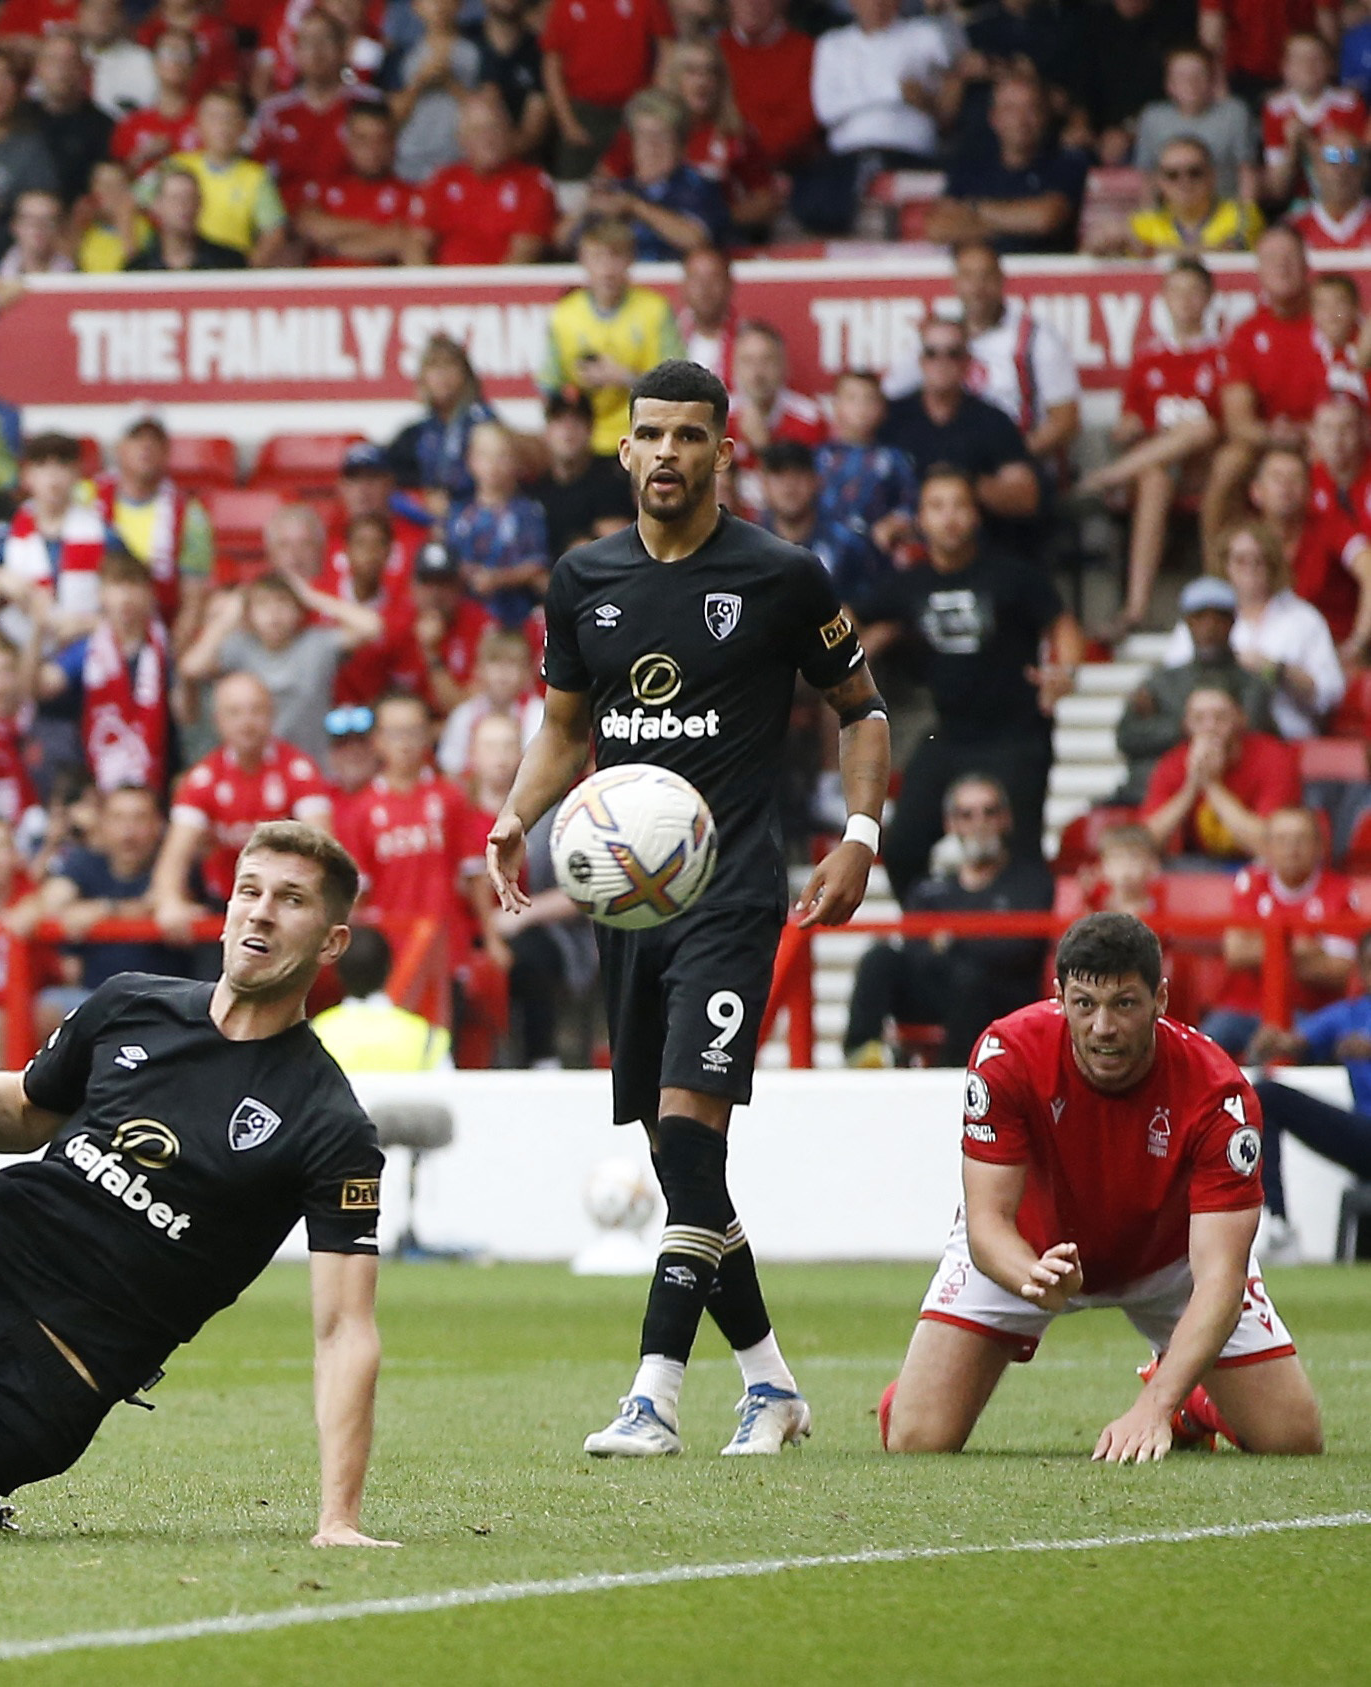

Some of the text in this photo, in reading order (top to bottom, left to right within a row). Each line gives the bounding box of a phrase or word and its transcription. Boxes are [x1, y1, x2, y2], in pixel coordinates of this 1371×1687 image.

[68, 303, 551, 385] THE FAMILY STAN
[810, 298, 926, 375] THE
[601, 707, 720, 745] dafabet
[706, 990, 745, 1049] 9
[64, 1133, 191, 1241] dafabet
